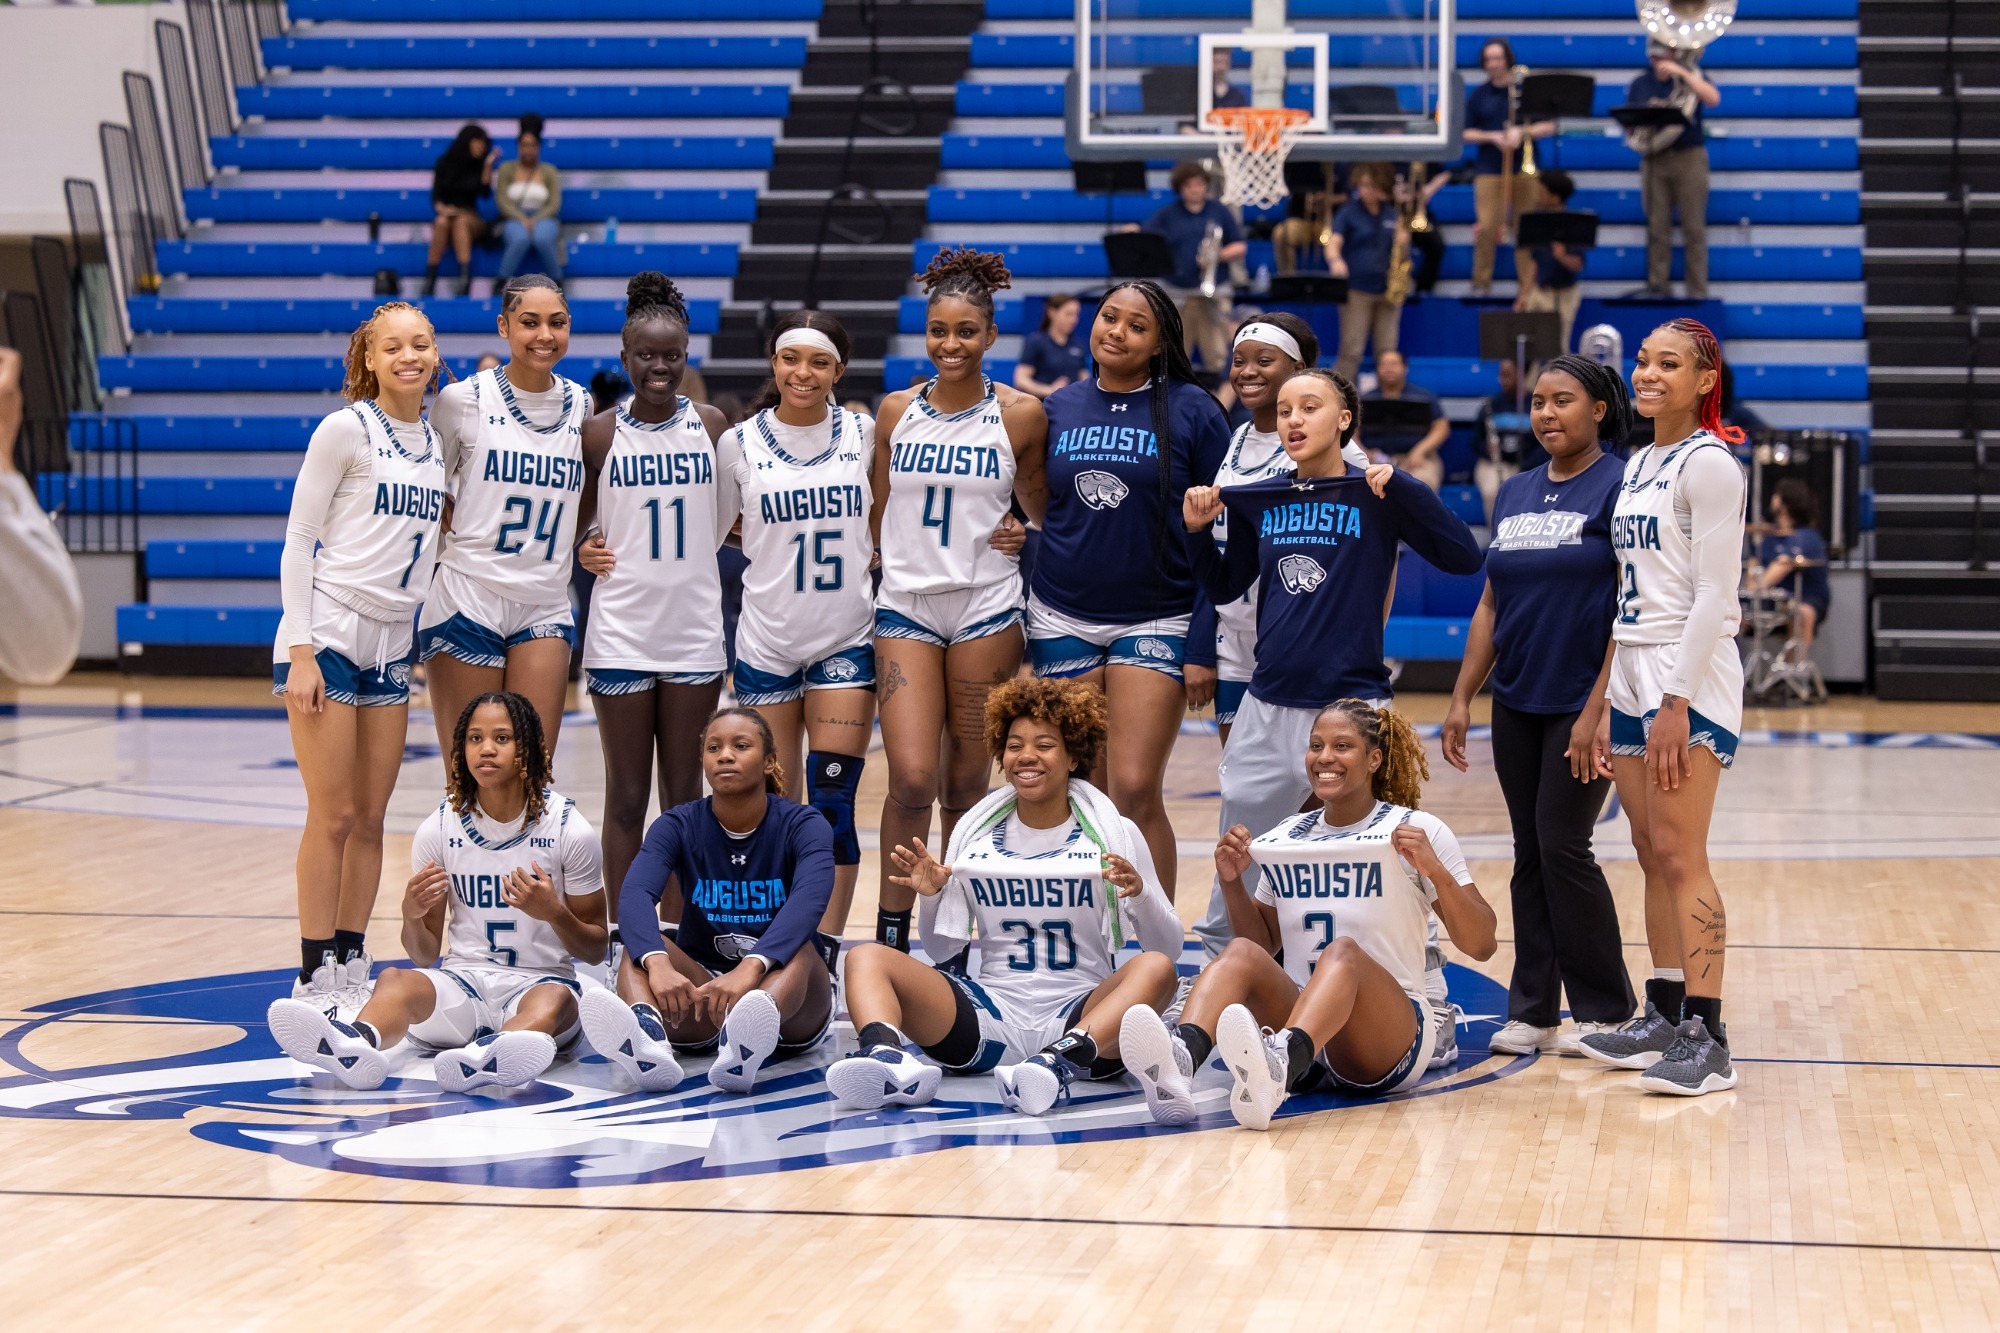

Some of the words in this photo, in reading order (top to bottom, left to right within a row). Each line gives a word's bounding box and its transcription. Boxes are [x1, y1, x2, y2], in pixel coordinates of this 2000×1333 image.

[839, 452, 860, 461] PBC
[1055, 425, 1159, 460] AUGUSTA
[1069, 453, 1139, 463] BASKETBALL
[484, 449, 581, 493] AUGUSTA
[609, 452, 712, 487] AUGUSTA
[891, 442, 1000, 480] AUGUSTA
[761, 485, 863, 524] AUGUSTA
[921, 483, 956, 549] 4
[1260, 502, 1361, 538] AUGUSTA
[492, 494, 565, 563] 24
[640, 496, 685, 561] 11
[1272, 536, 1338, 545] BASKETBALL
[1498, 514, 1583, 539] AUGUSTA
[398, 531, 425, 590] 1
[789, 528, 844, 594] 15
[1502, 541, 1556, 549] BASKETBALL
[530, 837, 555, 848] PBC
[1067, 852, 1097, 860] PBC
[692, 878, 787, 910] AUGUSTA
[969, 878, 1094, 908] AUGUSTA
[1260, 862, 1383, 898] AUGUSTA
[707, 913, 772, 924] BASKETBALL
[484, 920, 519, 967] 5
[999, 918, 1079, 973] 30
